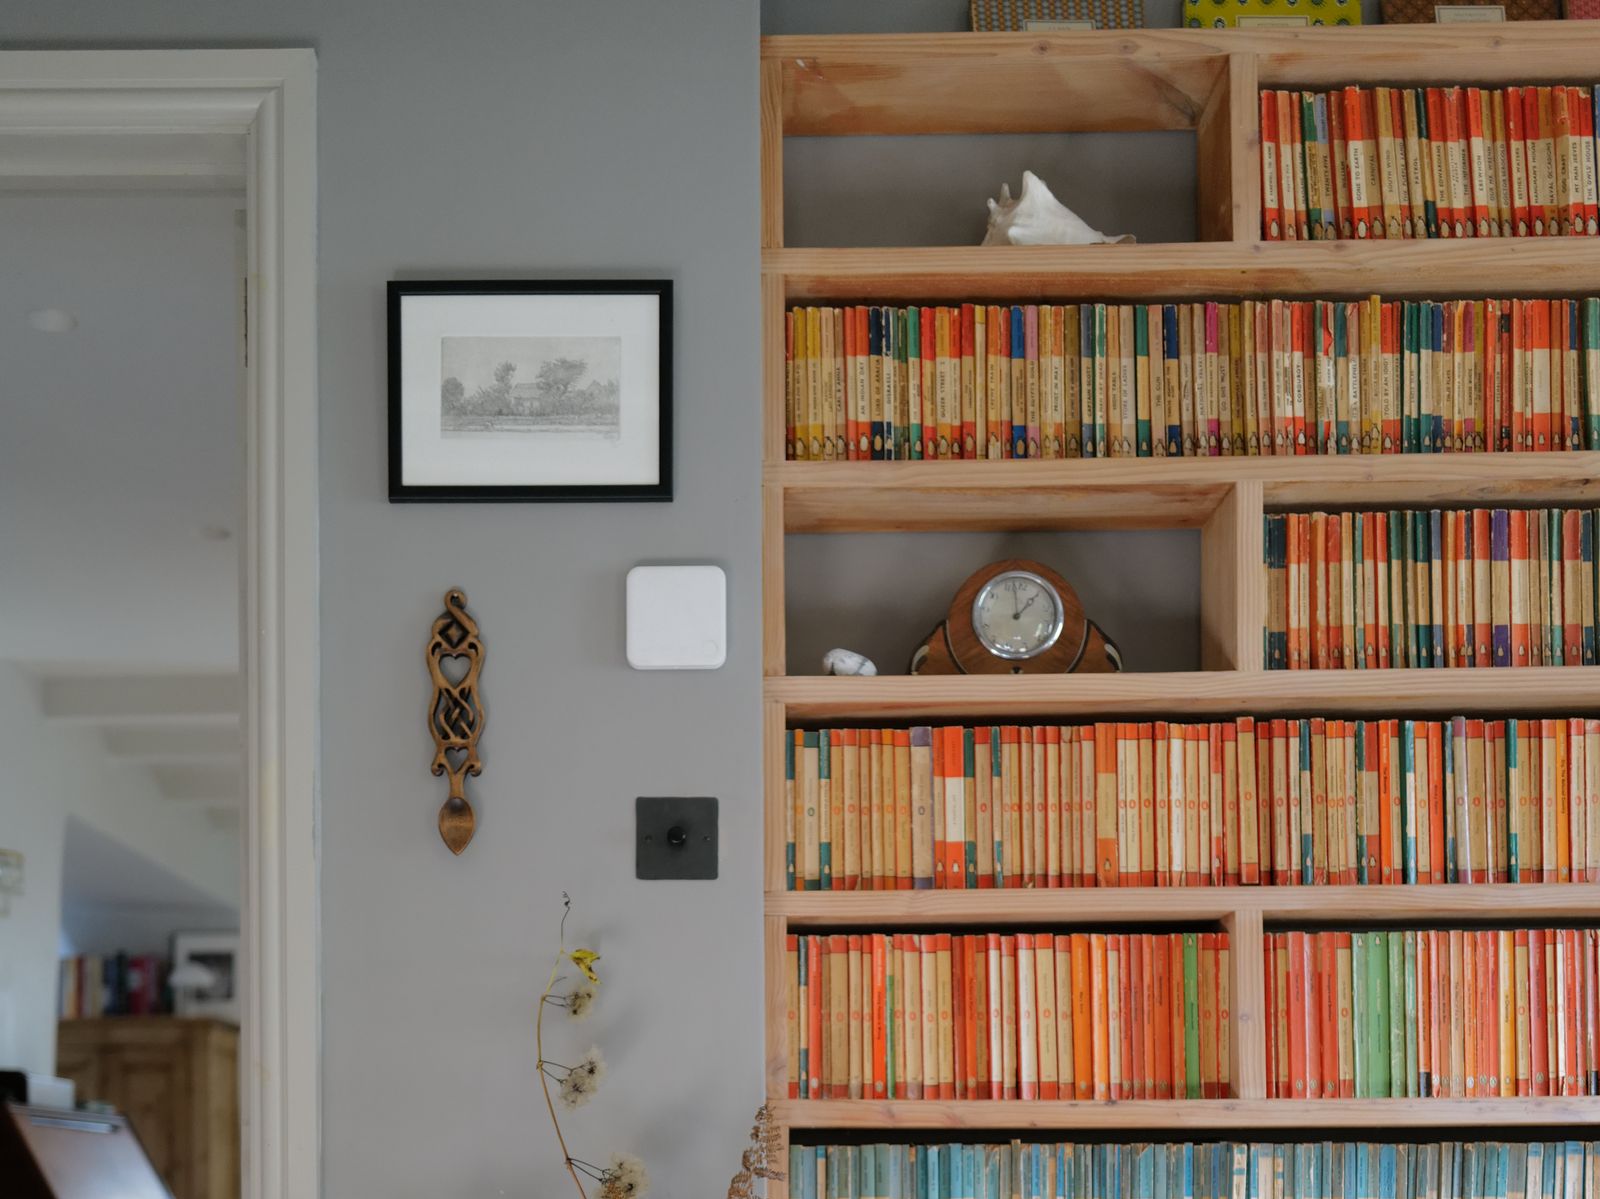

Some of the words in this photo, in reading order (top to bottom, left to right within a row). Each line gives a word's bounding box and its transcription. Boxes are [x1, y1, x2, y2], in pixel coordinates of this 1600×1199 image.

[1436, 145, 1444, 188] EDWARDIANS
[1355, 170, 1360, 180] TO
[1574, 184, 1580, 194] MY
[1383, 376, 1388, 386] AN
[1384, 388, 1389, 396] BY
